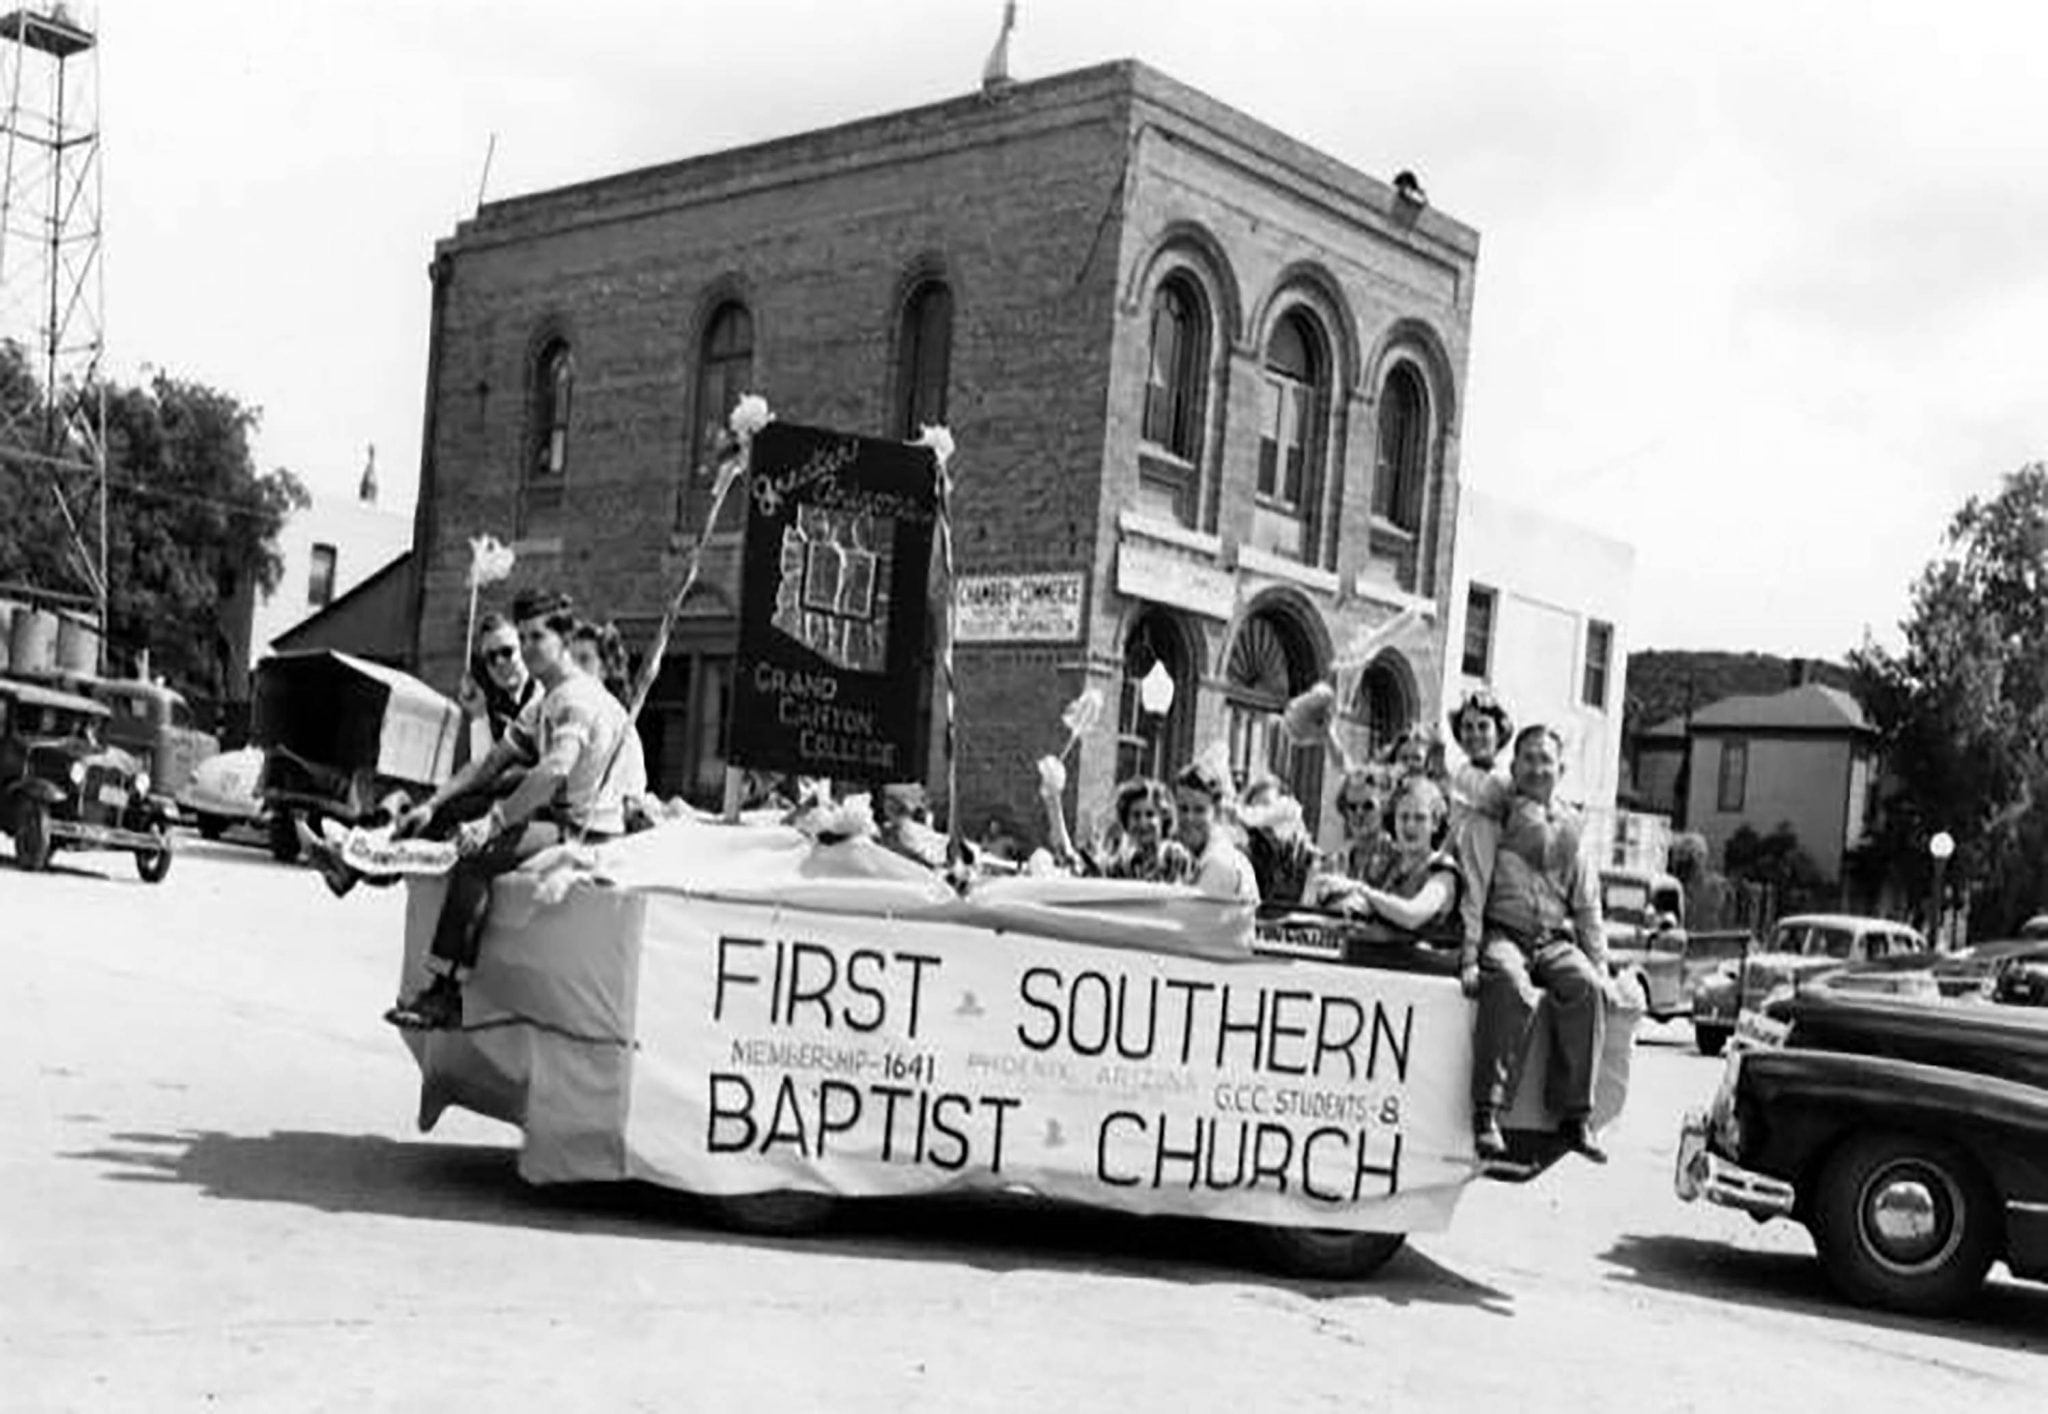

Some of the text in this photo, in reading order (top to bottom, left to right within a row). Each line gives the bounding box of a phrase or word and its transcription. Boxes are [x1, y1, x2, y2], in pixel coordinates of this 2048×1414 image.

[754, 661, 838, 700] GRAND
[714, 935, 1413, 1083] FIRST SOUTHERN
[708, 1072, 1402, 1205] BAPTIST CHURCH
